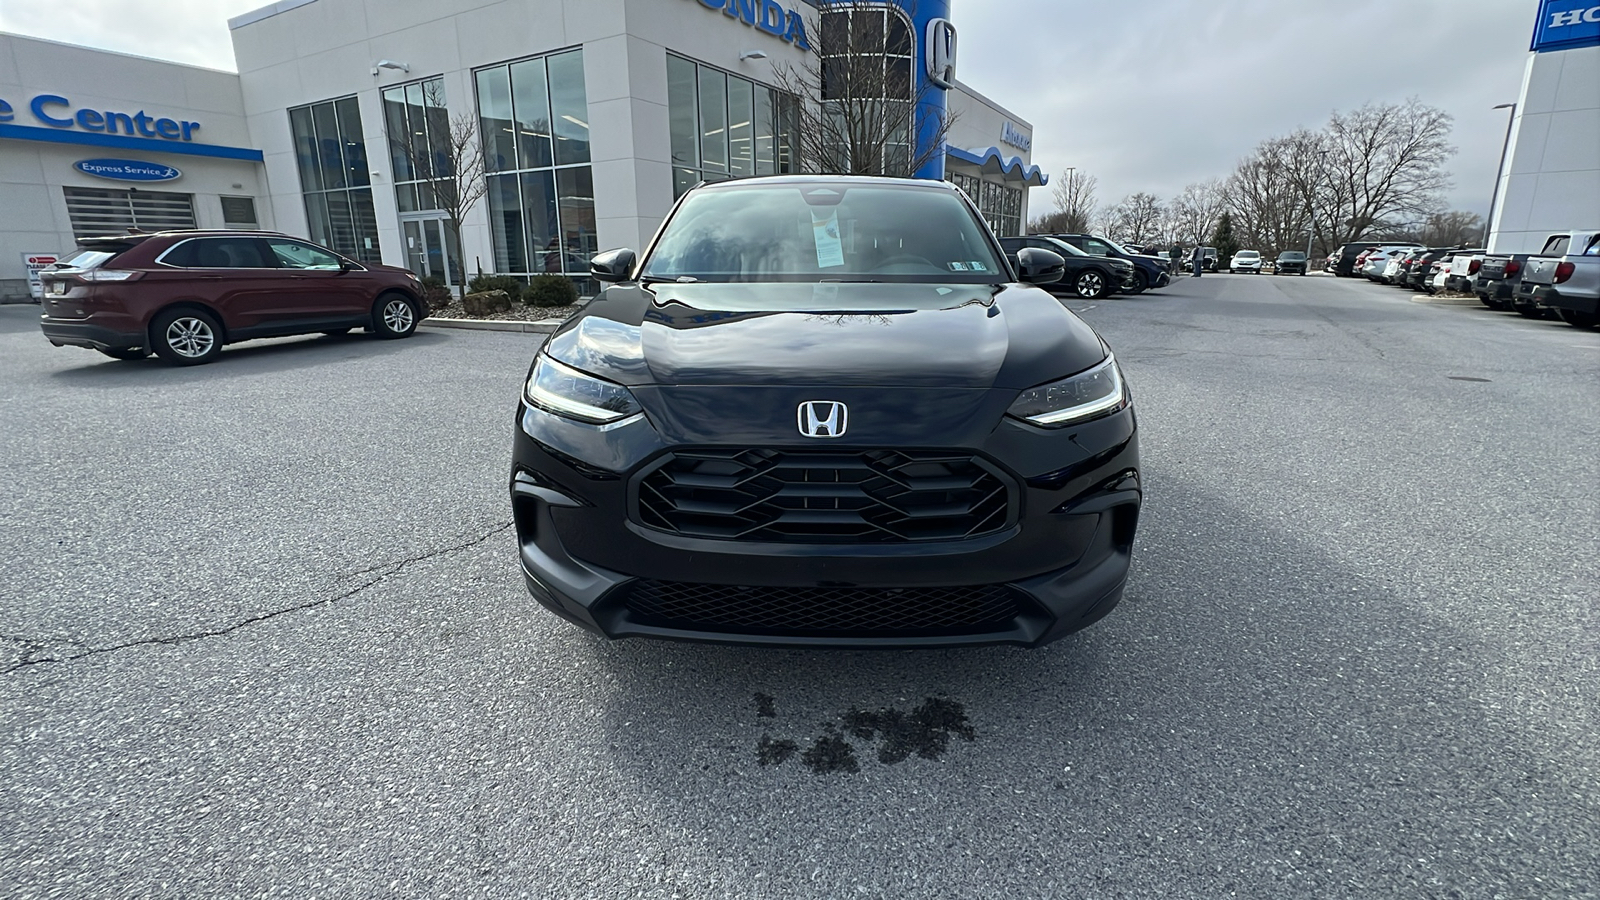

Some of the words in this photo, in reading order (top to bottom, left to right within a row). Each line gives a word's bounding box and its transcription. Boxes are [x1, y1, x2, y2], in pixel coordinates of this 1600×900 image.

[697, 0, 811, 51] NDA
[30, 94, 200, 141] Center
[82, 162, 123, 174] Express
[124, 166, 161, 176] Service
